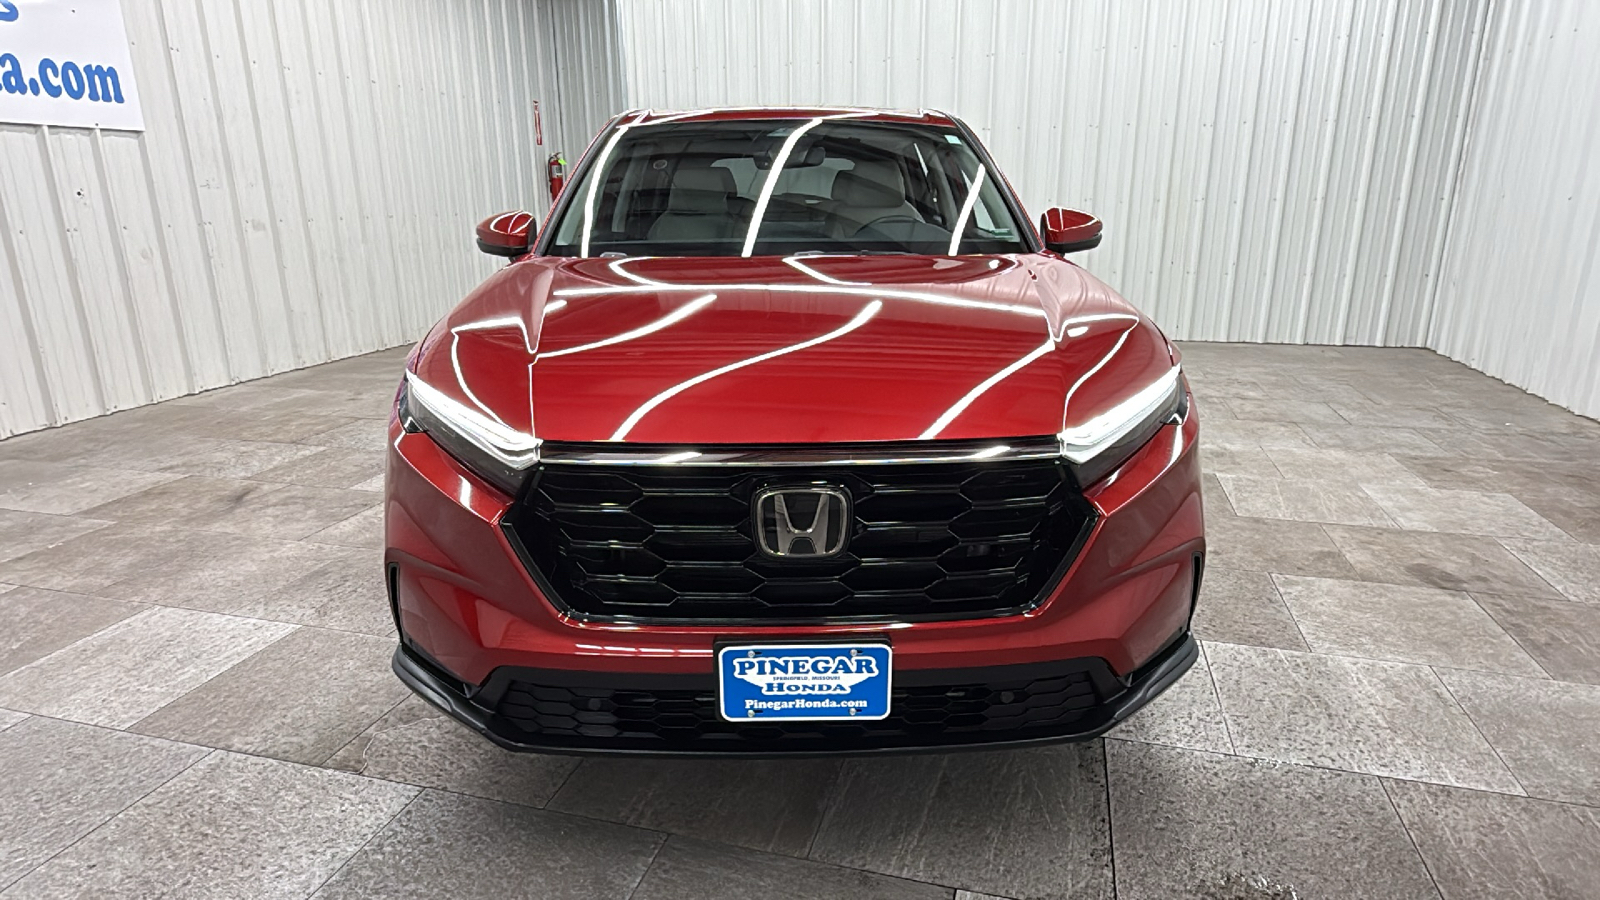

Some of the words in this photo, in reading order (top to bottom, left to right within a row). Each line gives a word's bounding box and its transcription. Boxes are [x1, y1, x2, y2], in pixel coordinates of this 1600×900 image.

[0, 53, 125, 104] a.com
[736, 658, 876, 676] PINEGAR
[765, 682, 848, 693] HONDA
[744, 698, 868, 711] PinegarHonda.com
